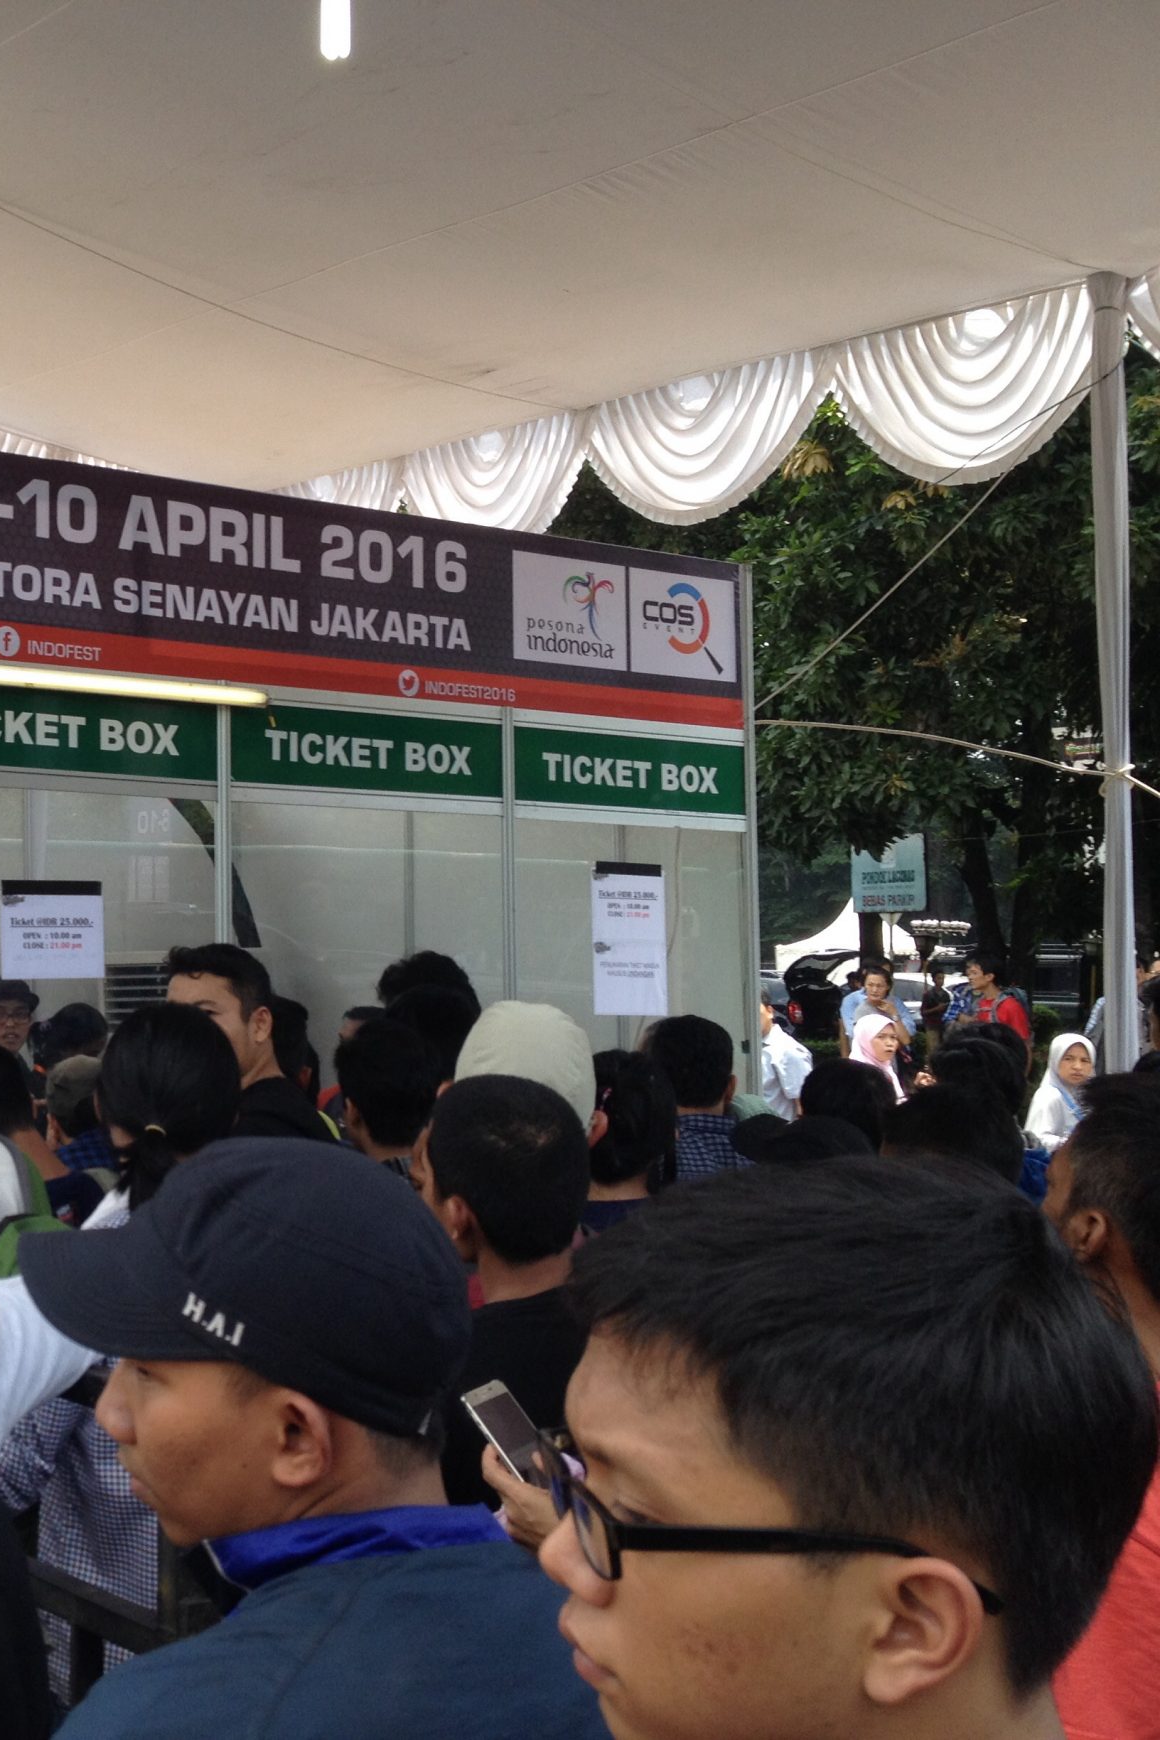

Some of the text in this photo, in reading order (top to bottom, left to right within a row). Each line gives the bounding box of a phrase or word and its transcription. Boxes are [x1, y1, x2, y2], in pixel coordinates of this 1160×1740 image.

[118, 494, 301, 573] APRIL
[320, 524, 467, 593] 2016
[113, 577, 299, 633] SENAYAN
[310, 602, 471, 651] JAKARTA
[526, 617, 585, 635] pesona
[642, 600, 695, 626] COS
[642, 622, 695, 635] EVENT
[27, 639, 102, 662] INDOFEST
[526, 632, 615, 660] indonesia
[424, 680, 516, 702] INDOFEST2016
[100, 718, 179, 757] BOX
[265, 729, 472, 776] TICKET BOX
[542, 752, 719, 794] TICKET BOX
[10, 917, 34, 926] Ticket
